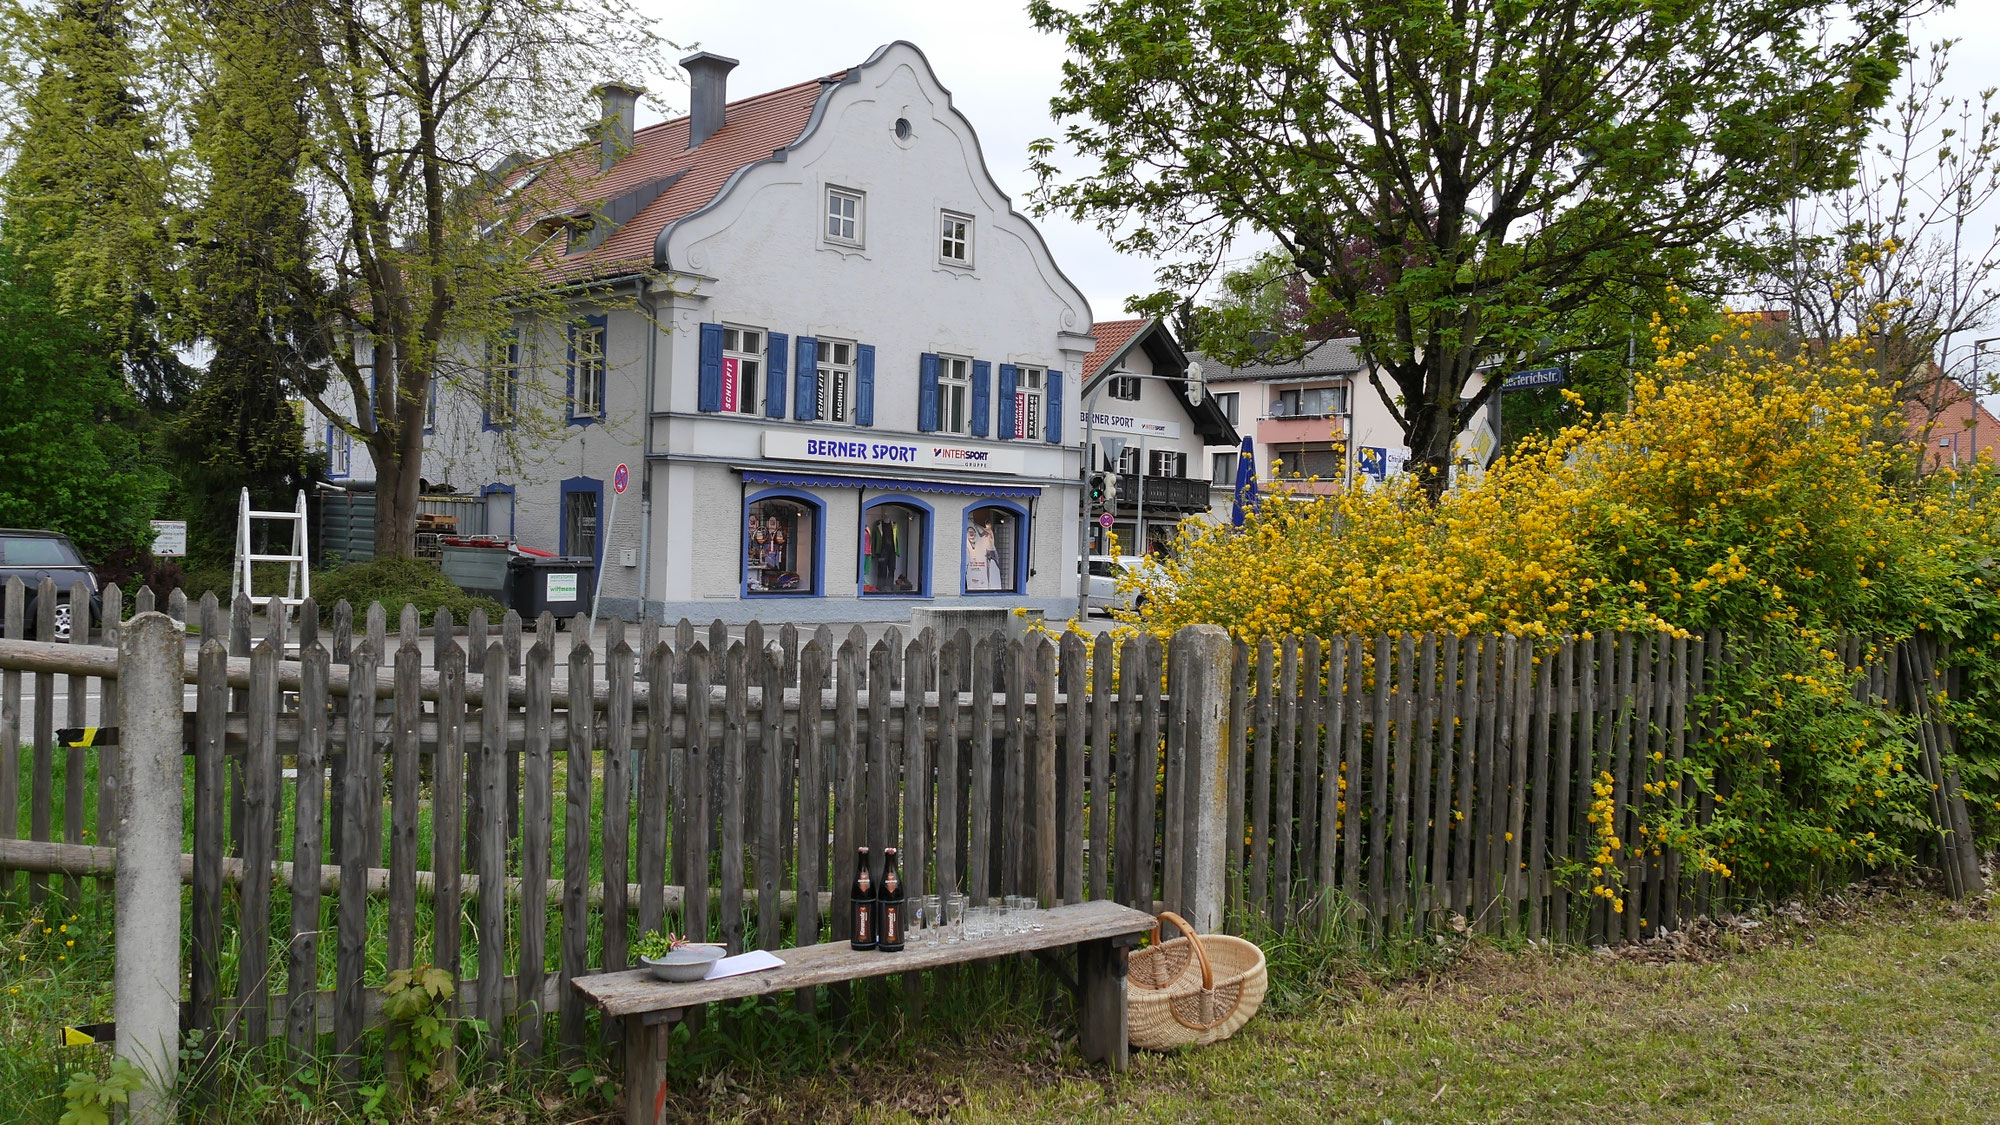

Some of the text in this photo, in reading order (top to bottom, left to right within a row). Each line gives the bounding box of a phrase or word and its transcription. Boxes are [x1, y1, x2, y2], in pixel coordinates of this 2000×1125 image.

[725, 361, 733, 410] SCHULFIT
[1502, 371, 1558, 387] erterichstr.
[836, 372, 844, 419] NACHHILFE
[1111, 416, 1134, 428] SPORT
[807, 439, 918, 463] BERNER SPORT
[942, 448, 989, 461] INTERSPORT
